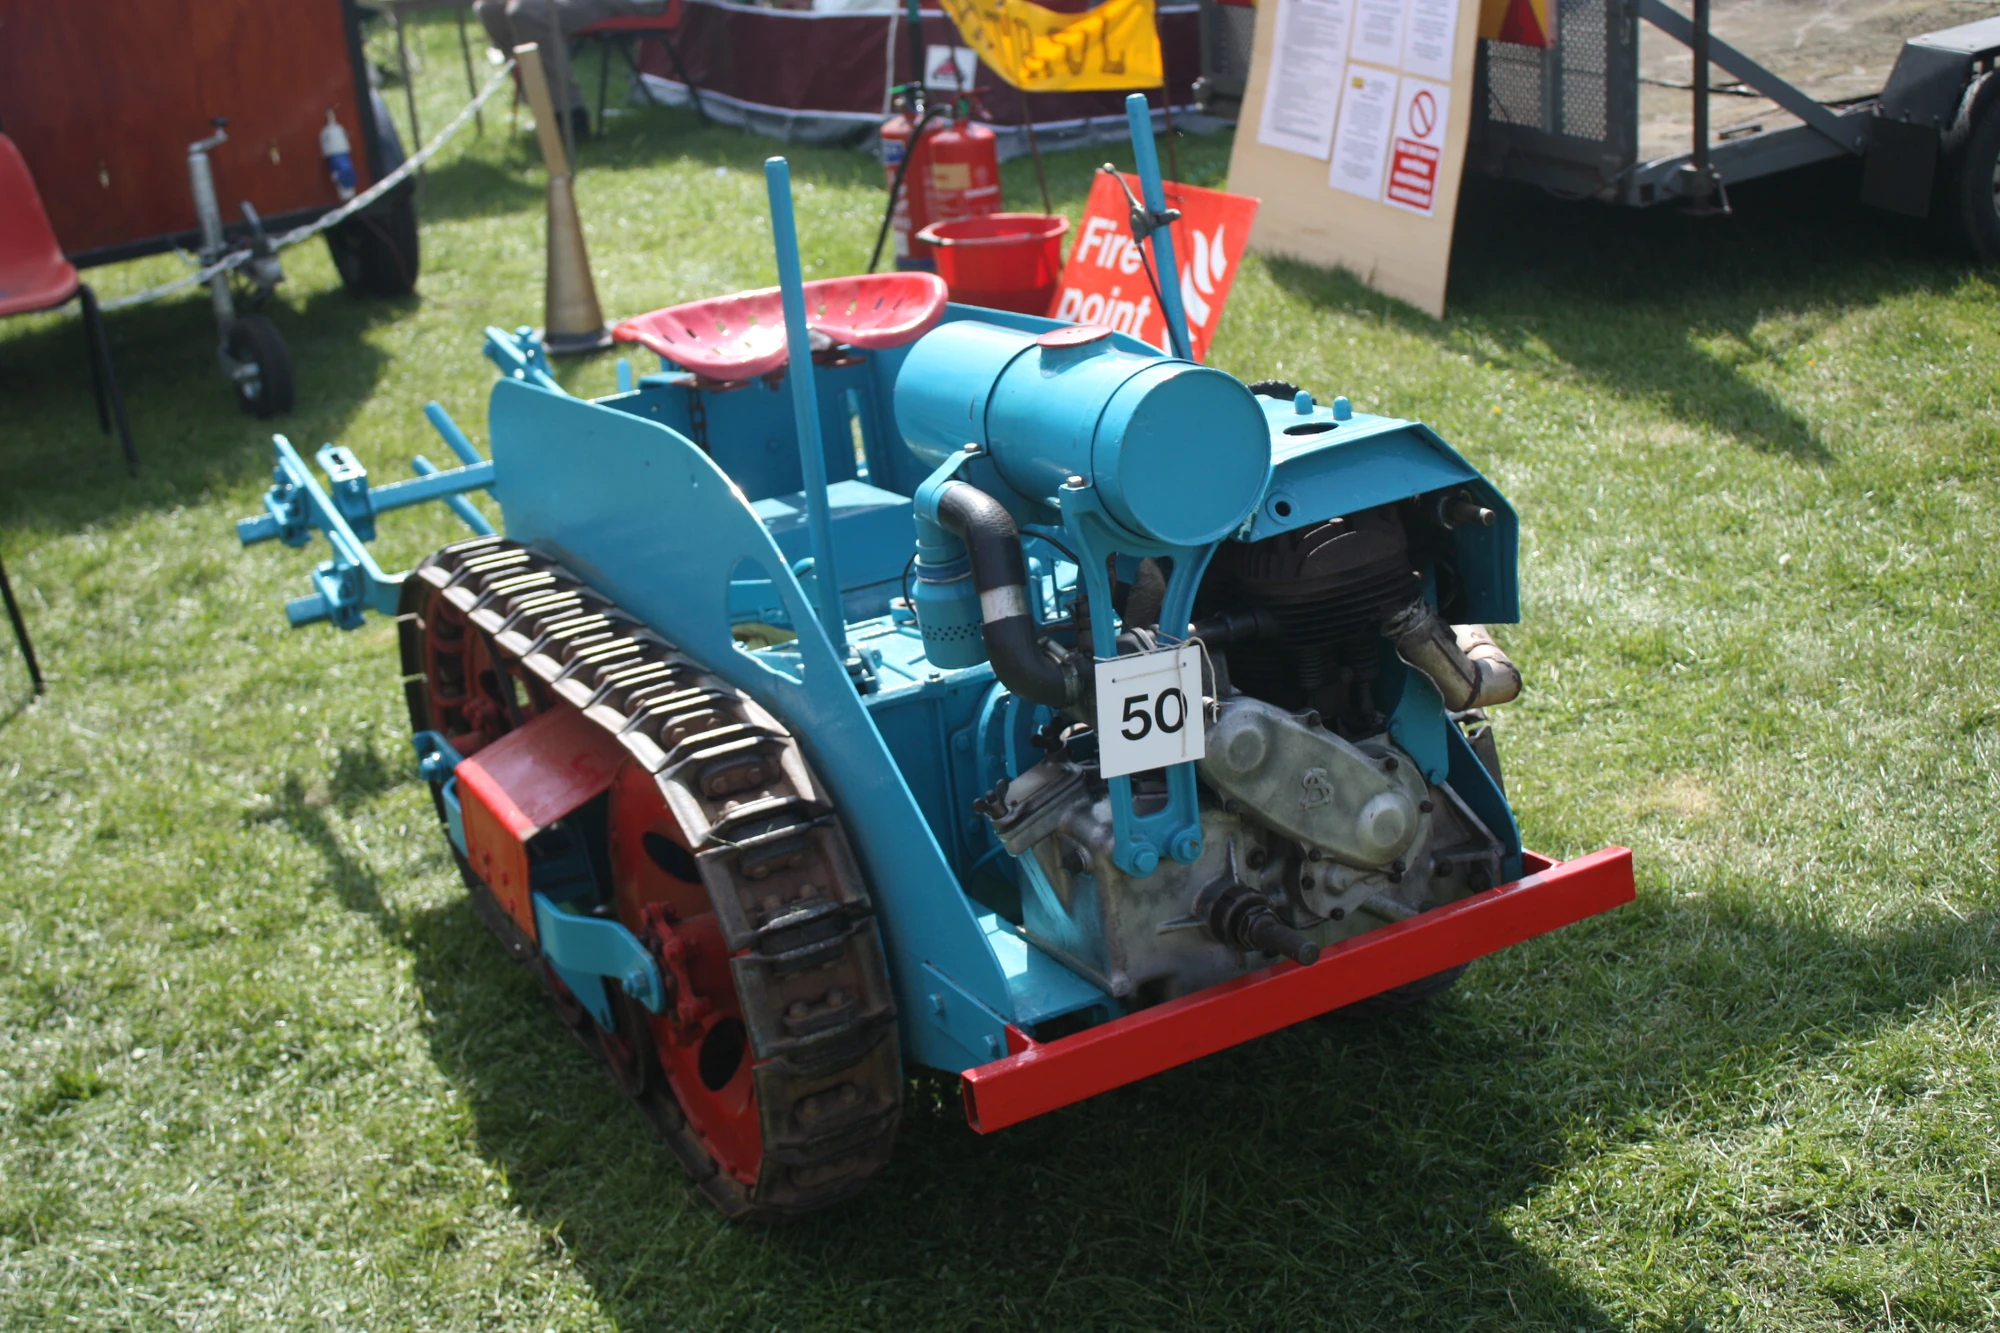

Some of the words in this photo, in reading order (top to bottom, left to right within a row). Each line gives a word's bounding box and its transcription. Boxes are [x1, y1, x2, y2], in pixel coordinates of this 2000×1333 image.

[1076, 215, 1147, 275] Fire
[1055, 286, 1151, 339] point
[1121, 687, 1188, 741] 50
